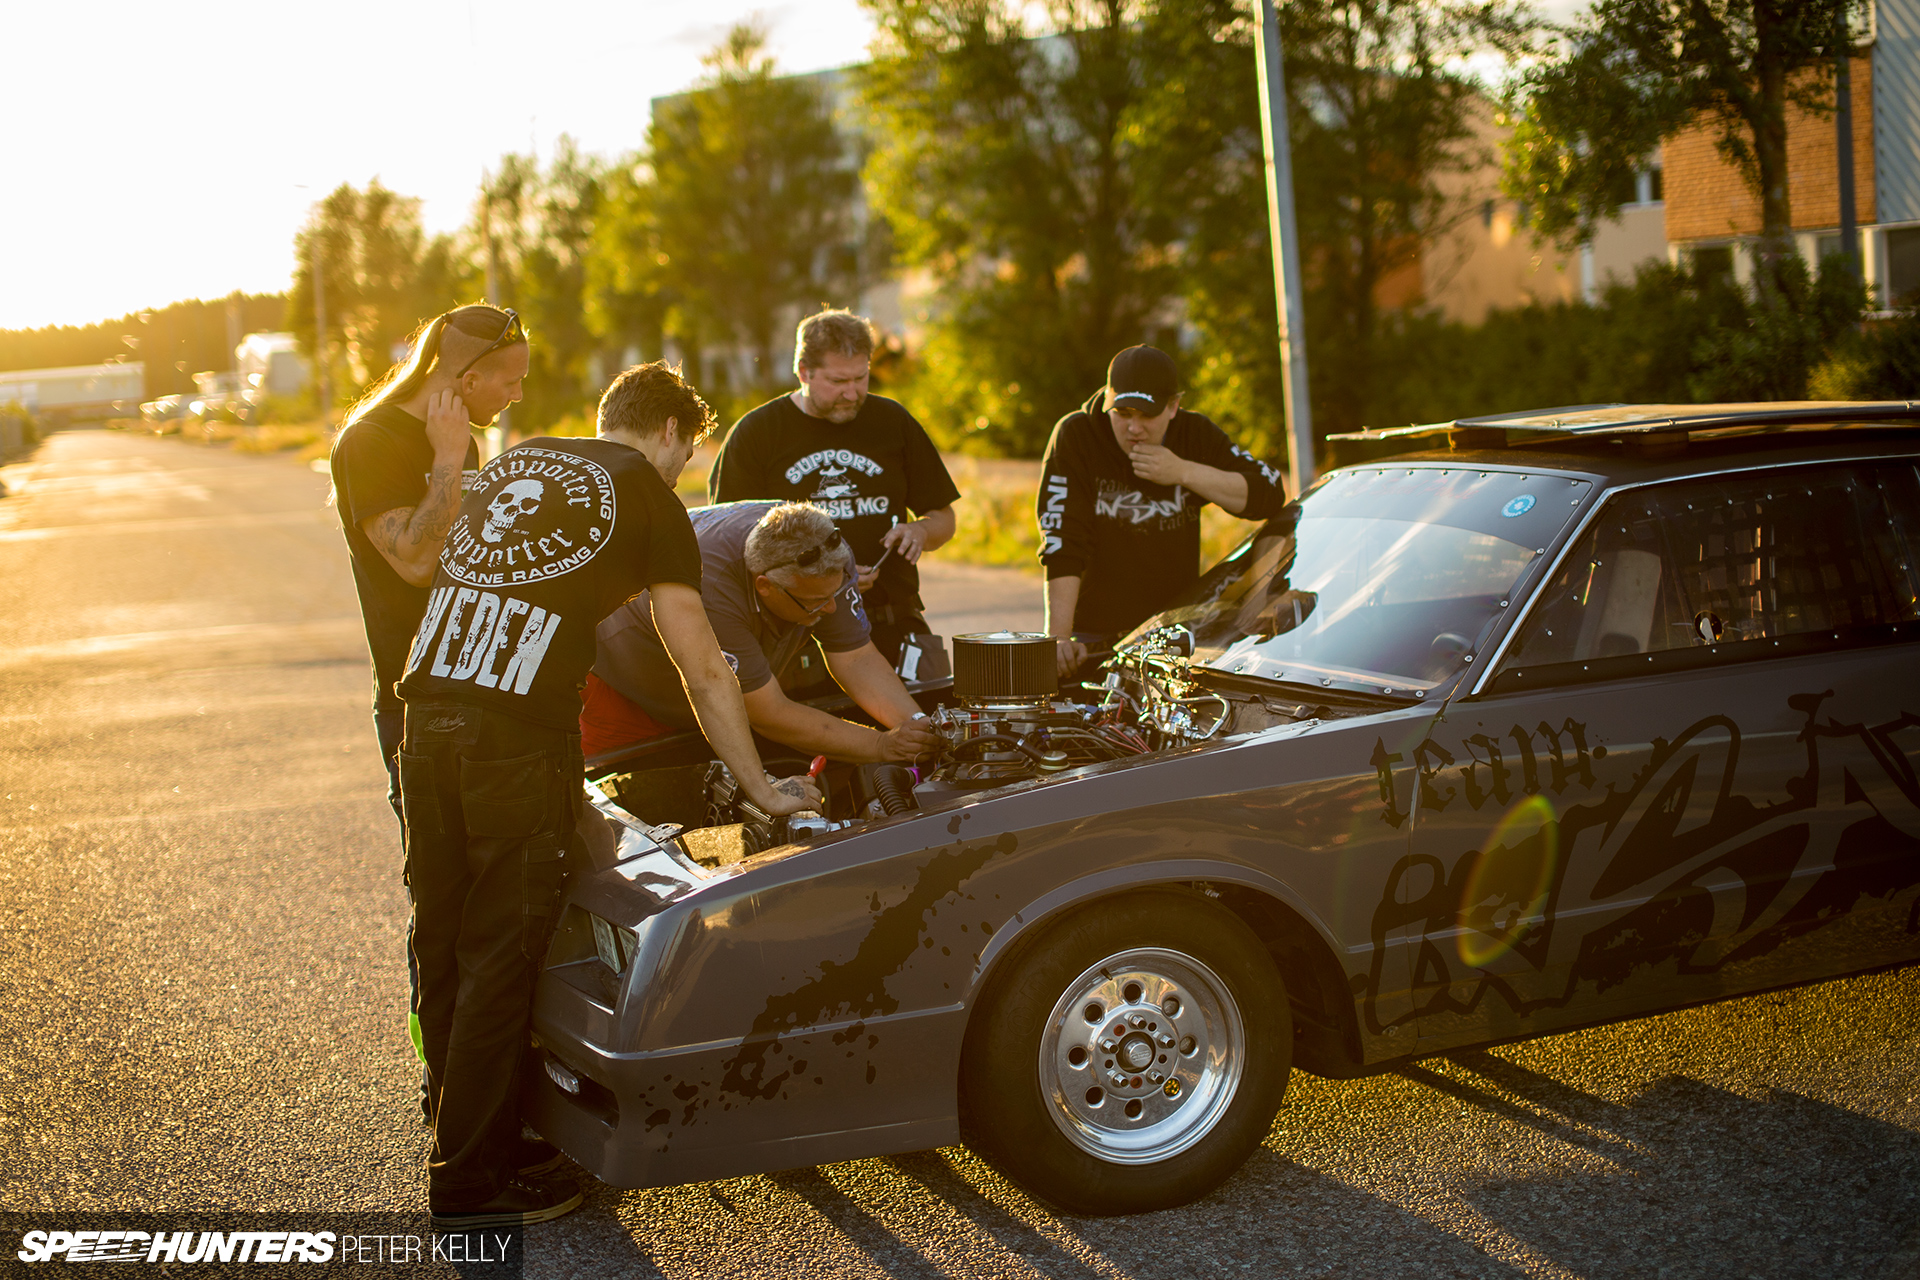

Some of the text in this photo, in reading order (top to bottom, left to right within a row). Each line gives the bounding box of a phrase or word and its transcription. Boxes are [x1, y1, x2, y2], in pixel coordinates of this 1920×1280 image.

[508, 449, 613, 521] INSANE RACING
[785, 449, 884, 485] SUPPORT
[855, 496, 889, 516] MC
[447, 545, 592, 584] INSANE RACING
